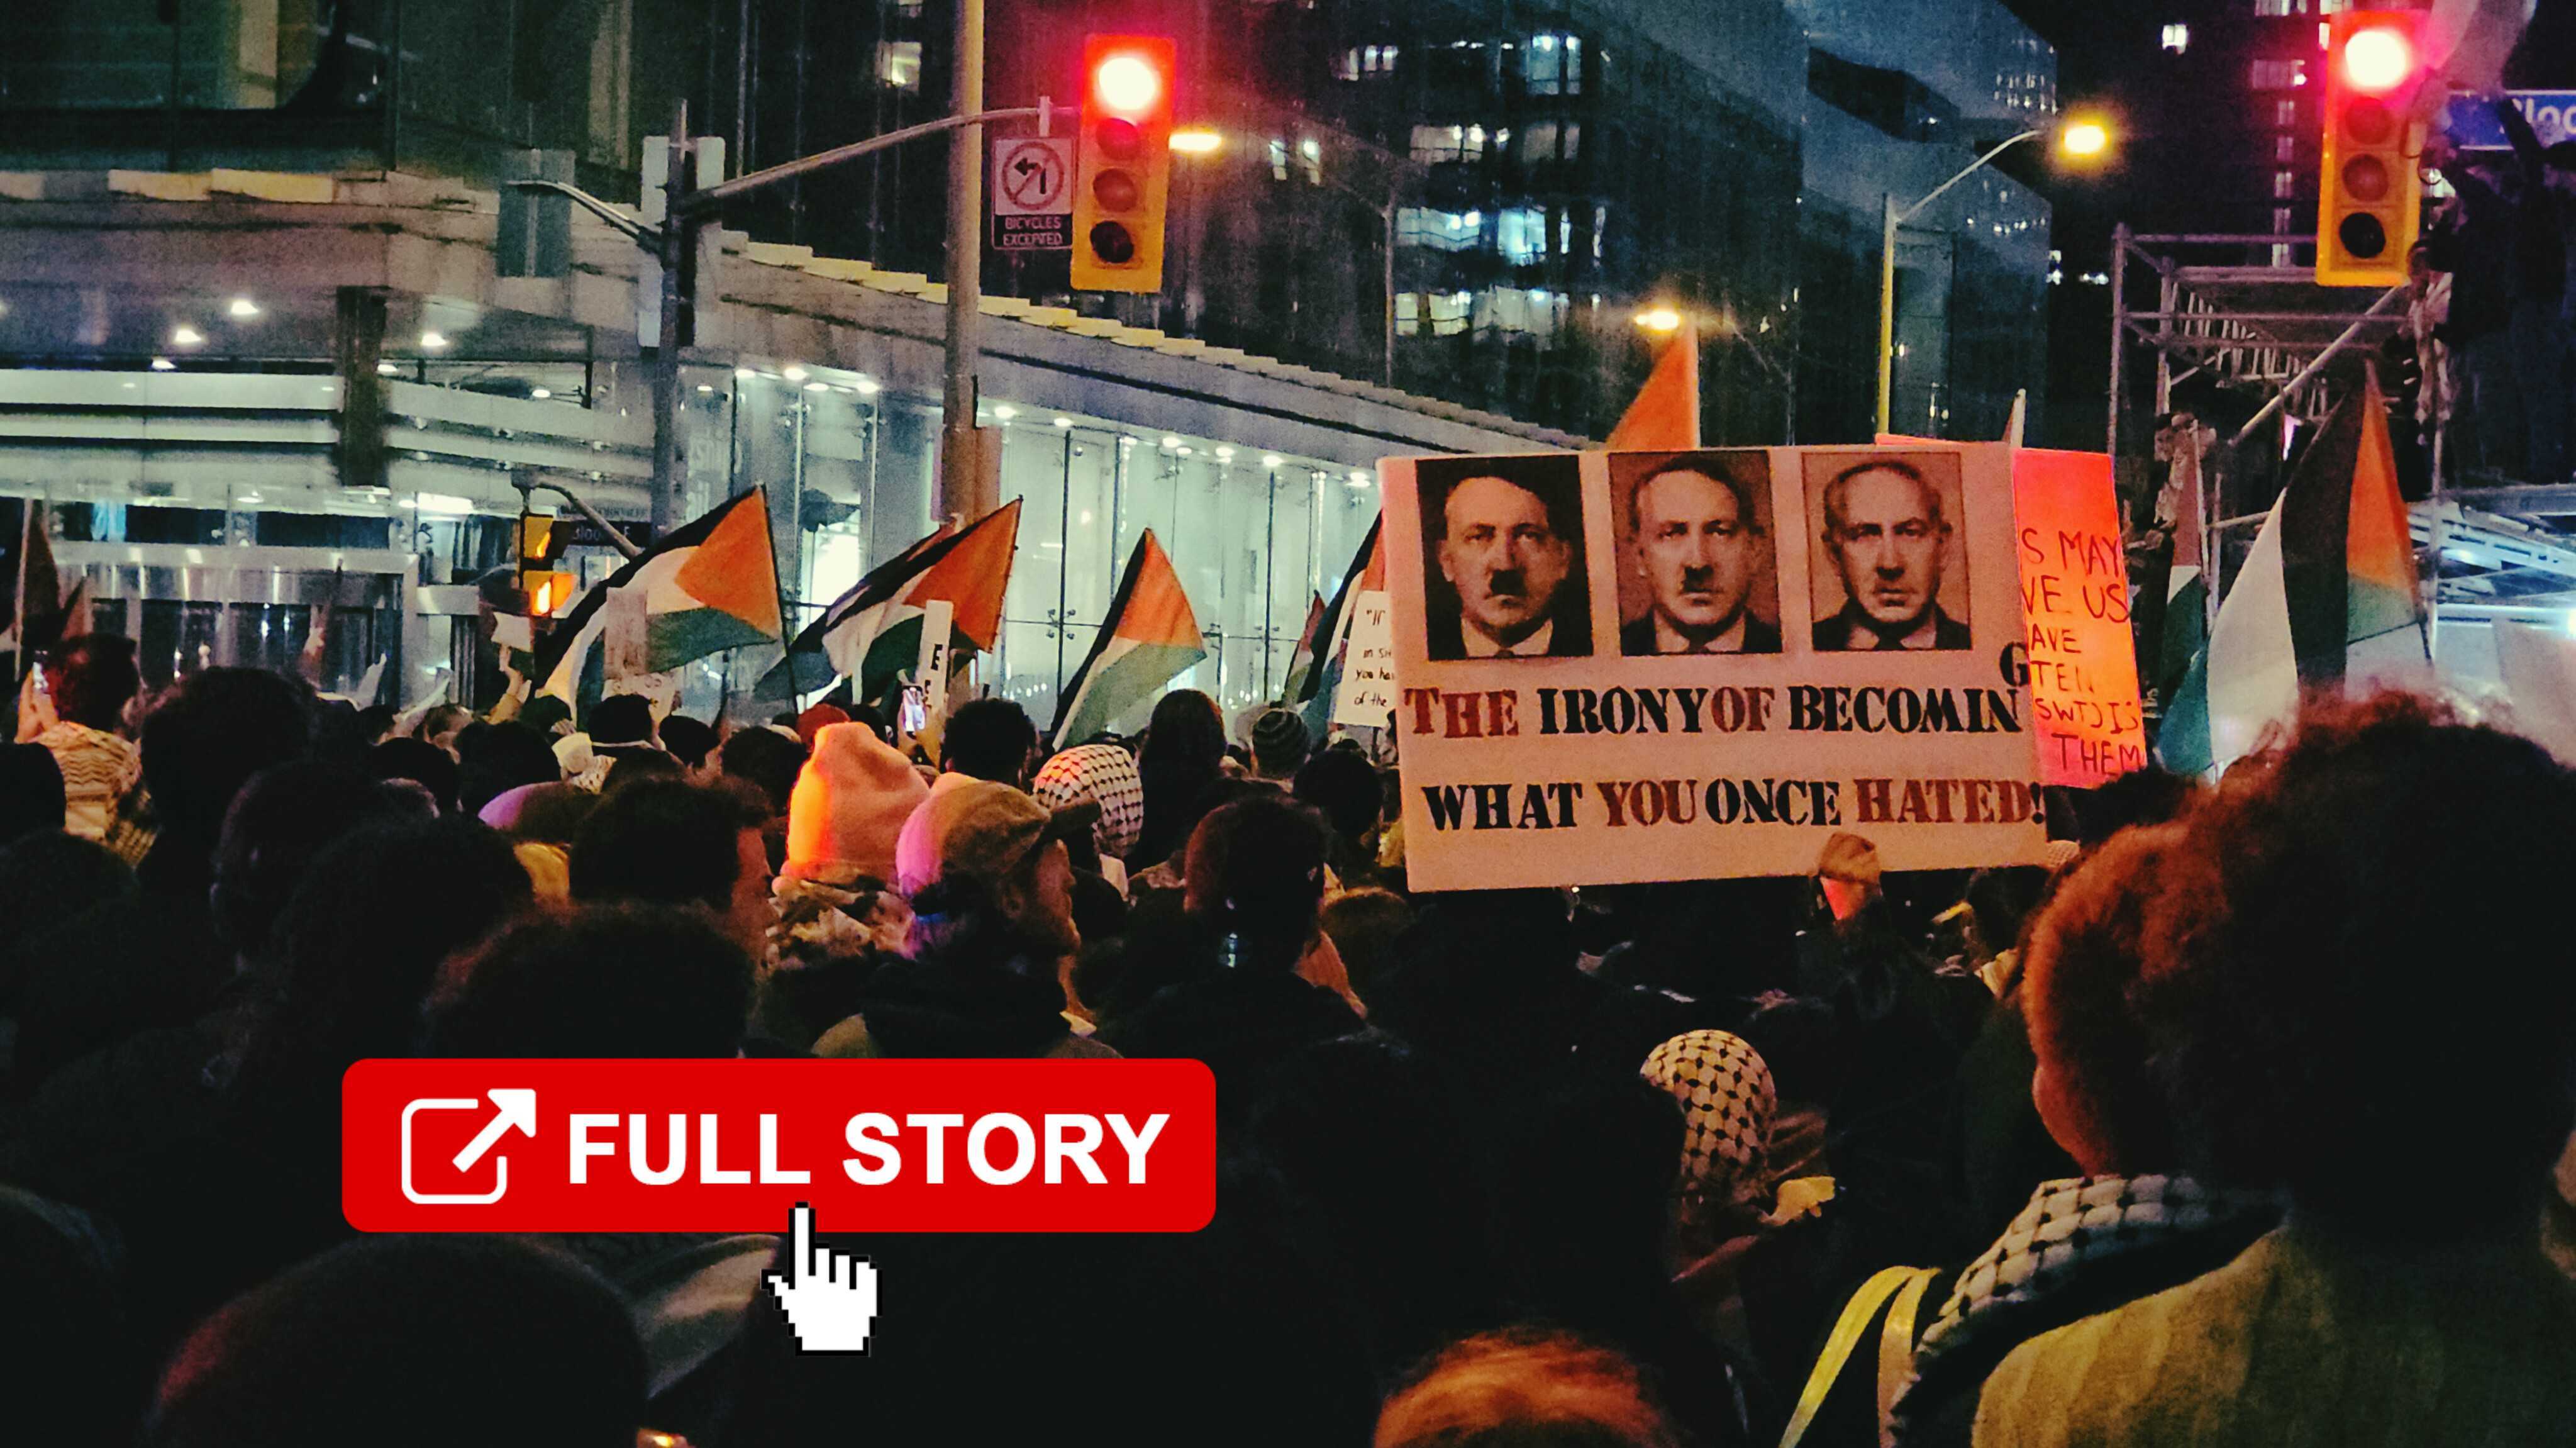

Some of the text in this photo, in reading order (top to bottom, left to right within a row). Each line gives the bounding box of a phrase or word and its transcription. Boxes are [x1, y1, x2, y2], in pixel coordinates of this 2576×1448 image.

[1003, 232, 1063, 245] EXCEPTED
[1005, 216, 1062, 229] BICYCLES
[2058, 531, 2119, 577] MAY
[2021, 575, 2131, 623] VE US
[2031, 623, 2082, 654] AVE
[1354, 691, 1387, 707] of the
[1404, 688, 1519, 738] THE
[1536, 685, 1709, 735] IRONY
[1711, 686, 1775, 734] OF
[2051, 733, 2142, 778] THEM
[1421, 778, 2045, 831] WHAT YOU ONCE HATED!
